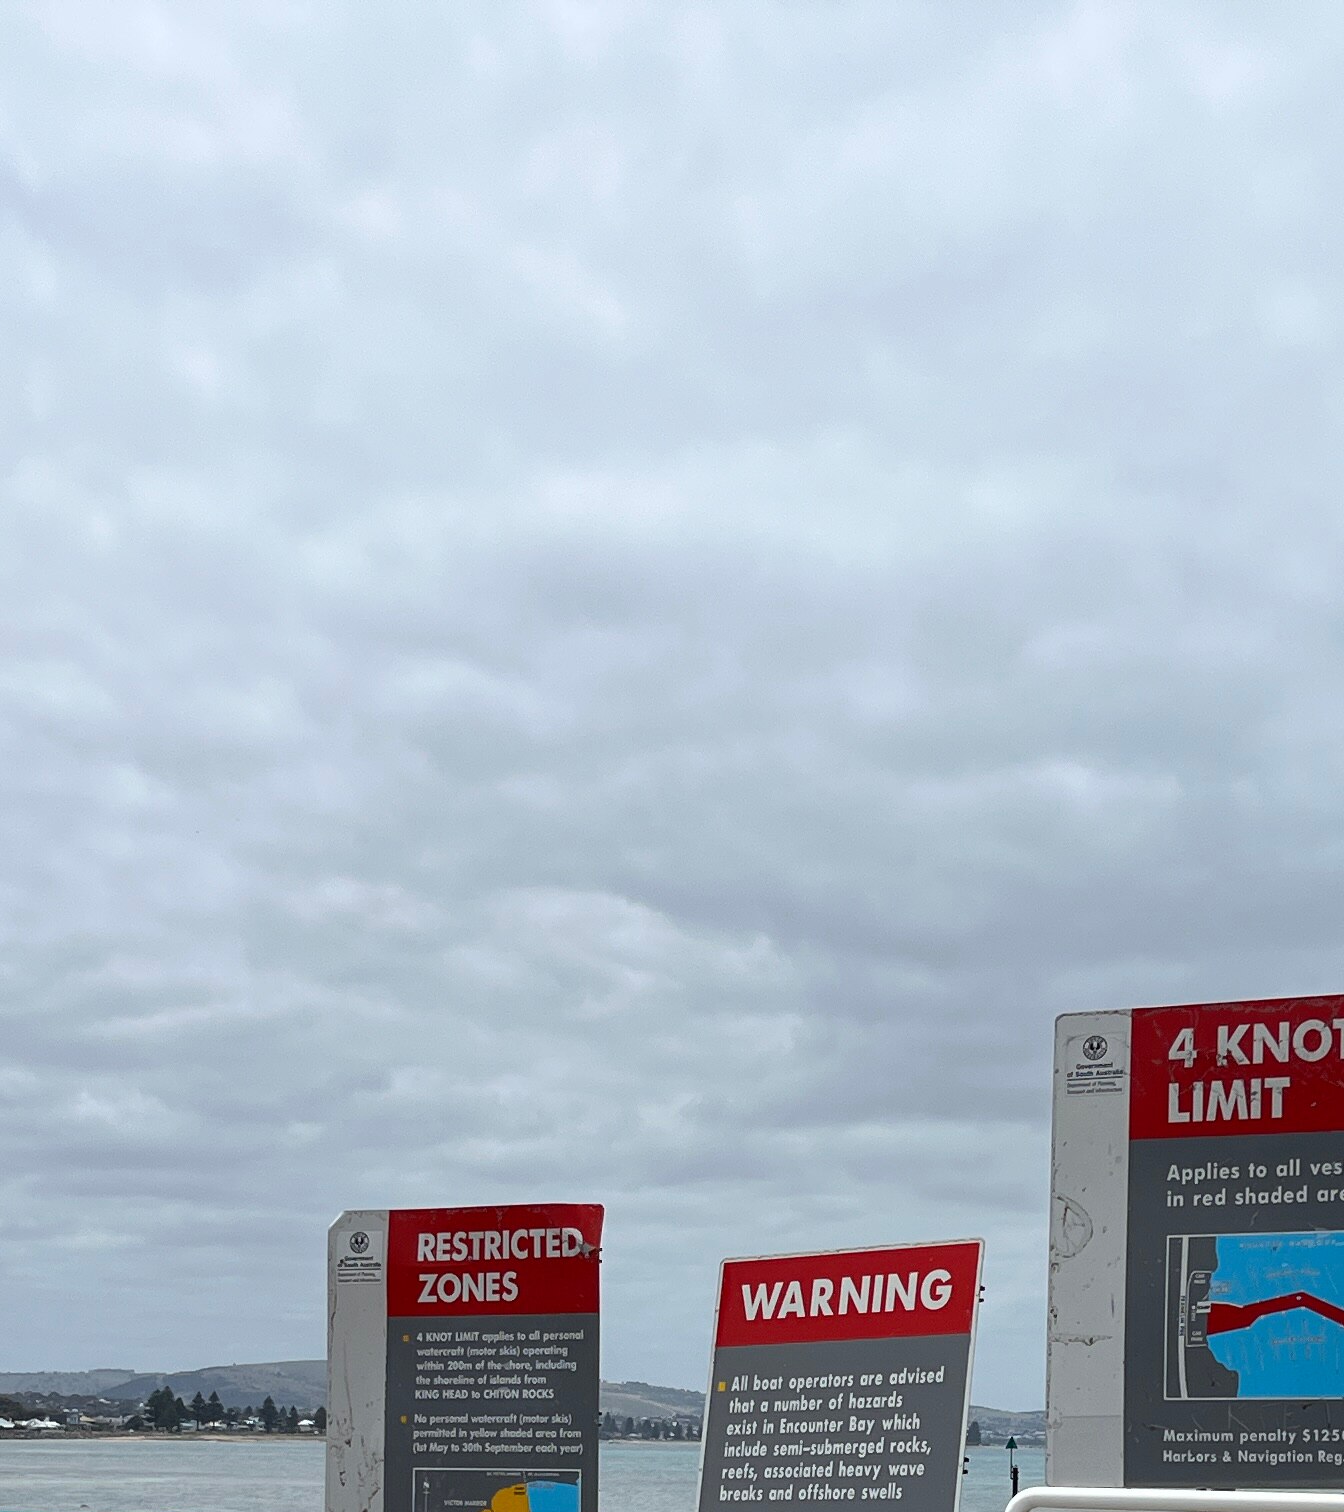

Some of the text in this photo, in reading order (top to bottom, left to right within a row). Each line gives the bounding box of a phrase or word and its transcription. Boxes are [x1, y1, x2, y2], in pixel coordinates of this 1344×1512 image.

[1169, 1028, 1198, 1067] 4
[1168, 1077, 1290, 1123] LIMIT
[1167, 1163, 1239, 1184] Applies
[1249, 1163, 1266, 1177] to
[1277, 1159, 1300, 1176] all
[1167, 1191, 1183, 1206] in
[1194, 1188, 1225, 1206] red
[1235, 1185, 1307, 1204] shaded
[417, 1228, 583, 1261] RESTRICTED
[418, 1271, 518, 1303] ZONES
[742, 1269, 952, 1320] WARNING
[417, 1330, 583, 1343] 4 KNOT LIMIT applies to all personal
[731, 1366, 944, 1393] All boat operators are advised
[415, 1387, 554, 1399] KING HEAD to CHITON ROCKS
[730, 1391, 902, 1413] that a number of hazards
[727, 1413, 920, 1435] exist in Encounter Bay which
[724, 1436, 931, 1457] include semi-submerged rocks,
[1164, 1429, 1233, 1441] Maximum
[1240, 1429, 1296, 1444] penalty
